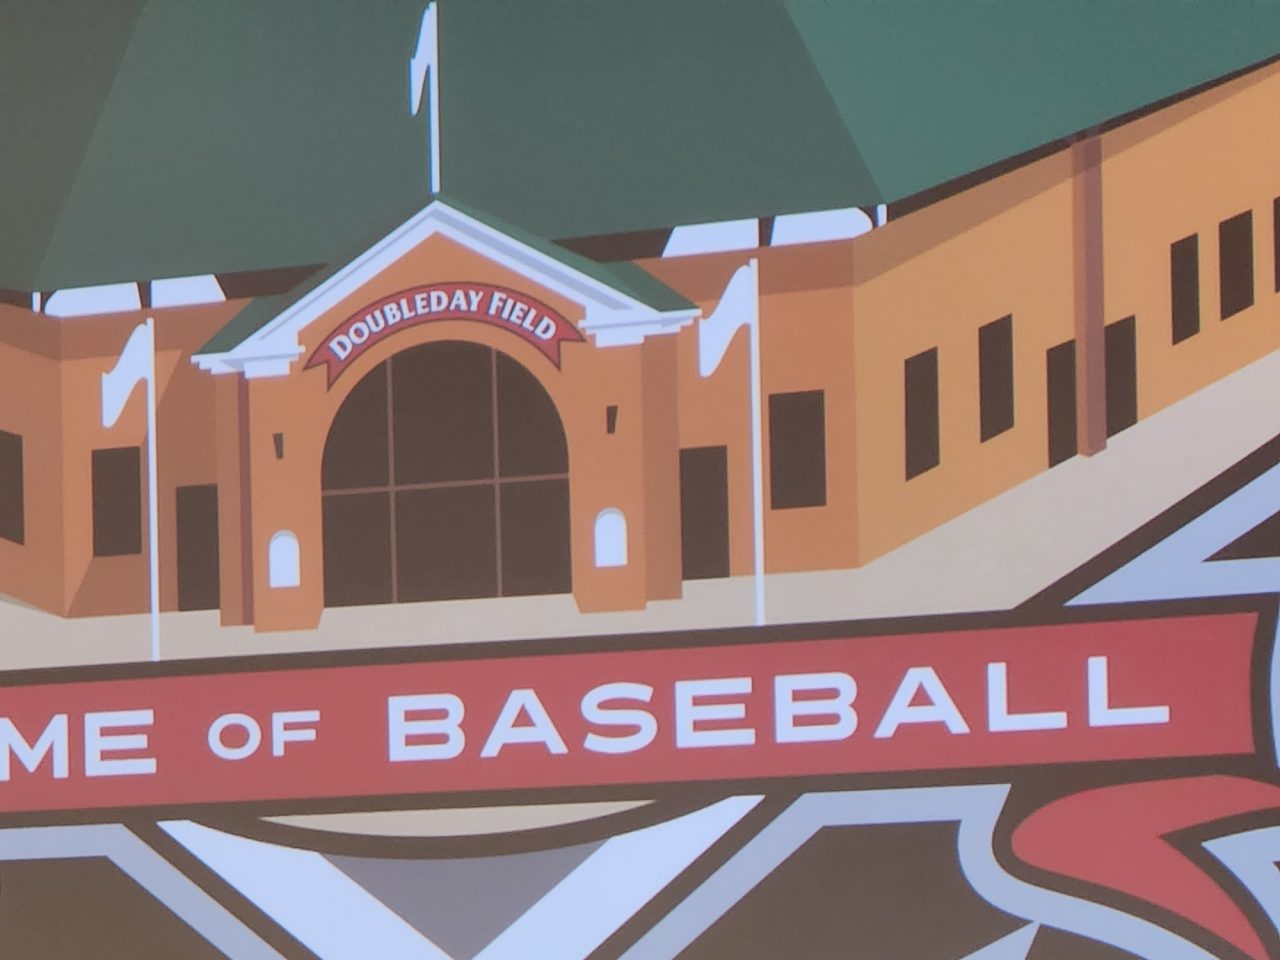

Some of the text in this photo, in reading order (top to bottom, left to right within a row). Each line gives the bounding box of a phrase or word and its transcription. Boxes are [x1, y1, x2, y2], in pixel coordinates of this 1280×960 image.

[328, 289, 557, 361] DOUBLEDAY FIELD
[207, 710, 321, 760] OF
[387, 656, 1170, 763] BASEBALL
